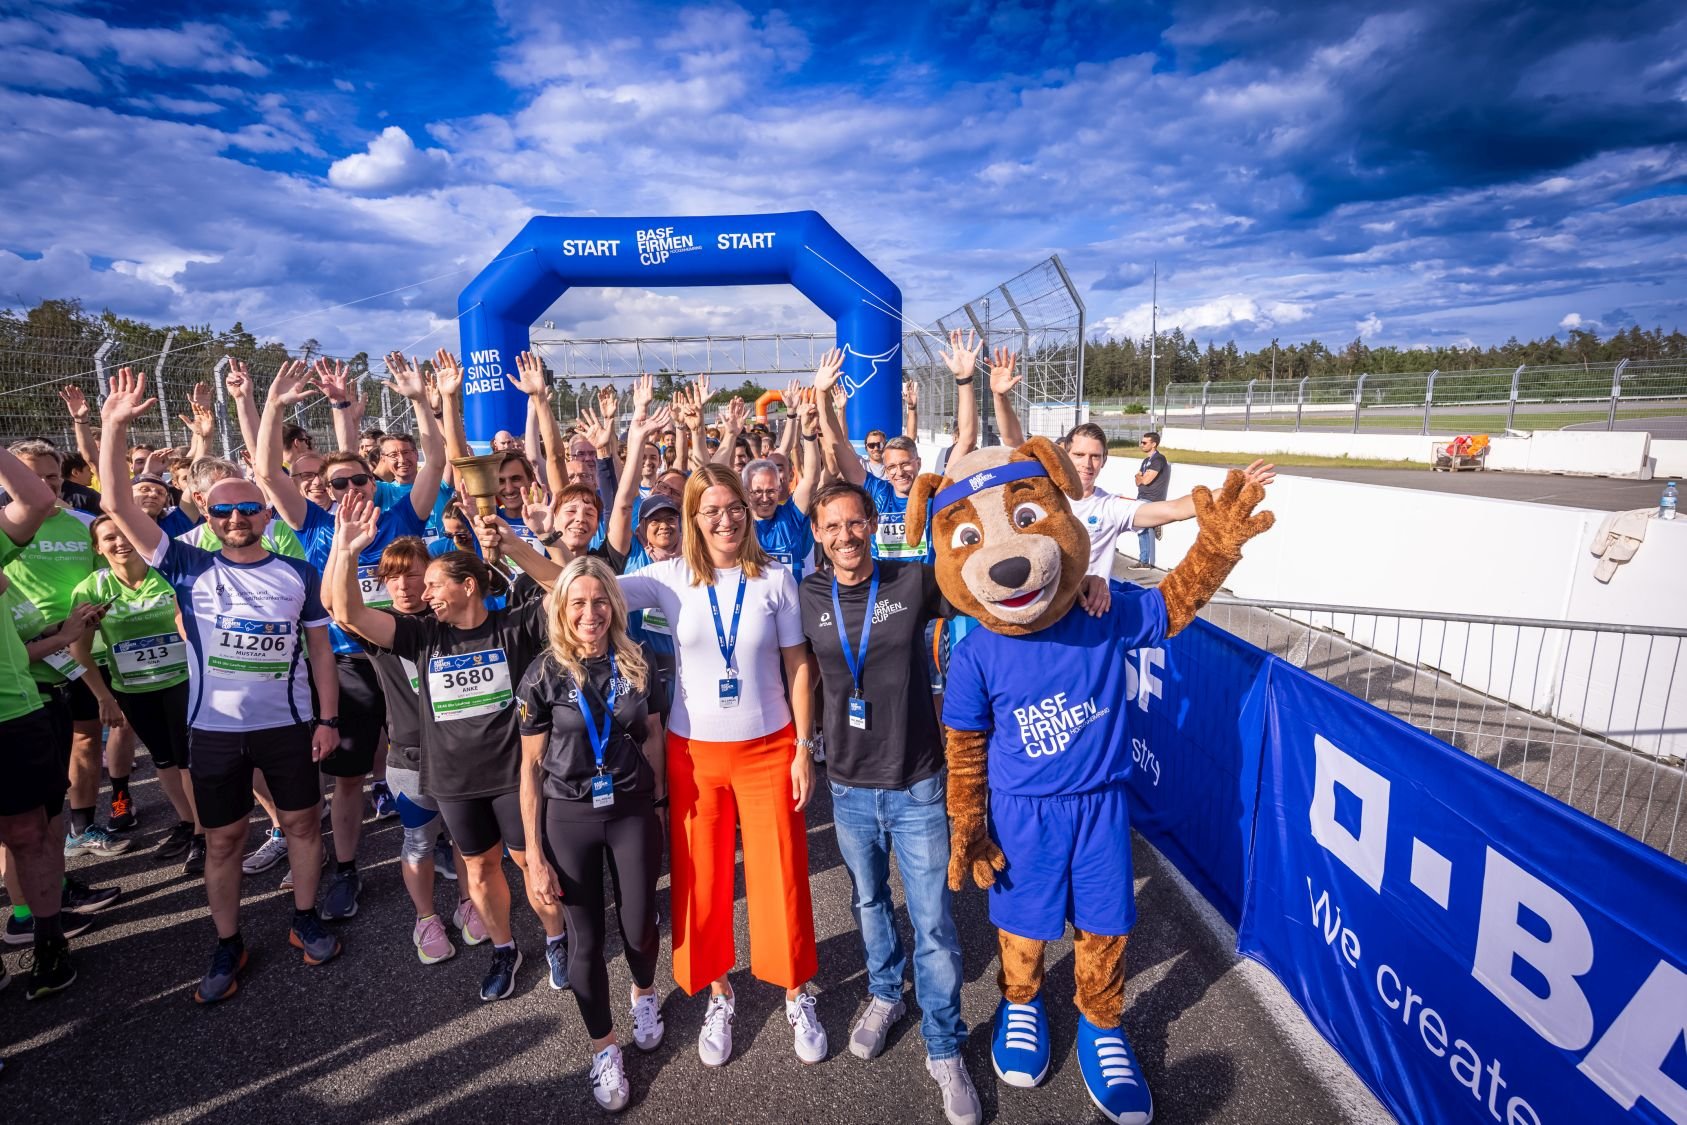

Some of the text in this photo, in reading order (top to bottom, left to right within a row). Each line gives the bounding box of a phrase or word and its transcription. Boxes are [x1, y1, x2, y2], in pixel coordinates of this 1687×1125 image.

[636, 226, 674, 242] BASF
[717, 232, 776, 250] START
[563, 240, 620, 256] START
[637, 234, 694, 254] FIRMEN
[640, 250, 670, 266] CUP
[470, 349, 501, 365] WIR
[467, 363, 503, 380] SIND
[464, 377, 505, 396] DABEI
[39, 540, 88, 553] BASF
[872, 601, 902, 617] IRMEN
[873, 598, 890, 610] ASF
[871, 613, 889, 624] CUP
[219, 632, 286, 652] 11206
[134, 646, 169, 662] 213
[442, 667, 494, 689] 3680
[1012, 691, 1068, 726] BASF
[1020, 696, 1097, 745] FIRMEN
[1025, 731, 1070, 758] CUP
[1306, 875, 1541, 1125] We create
